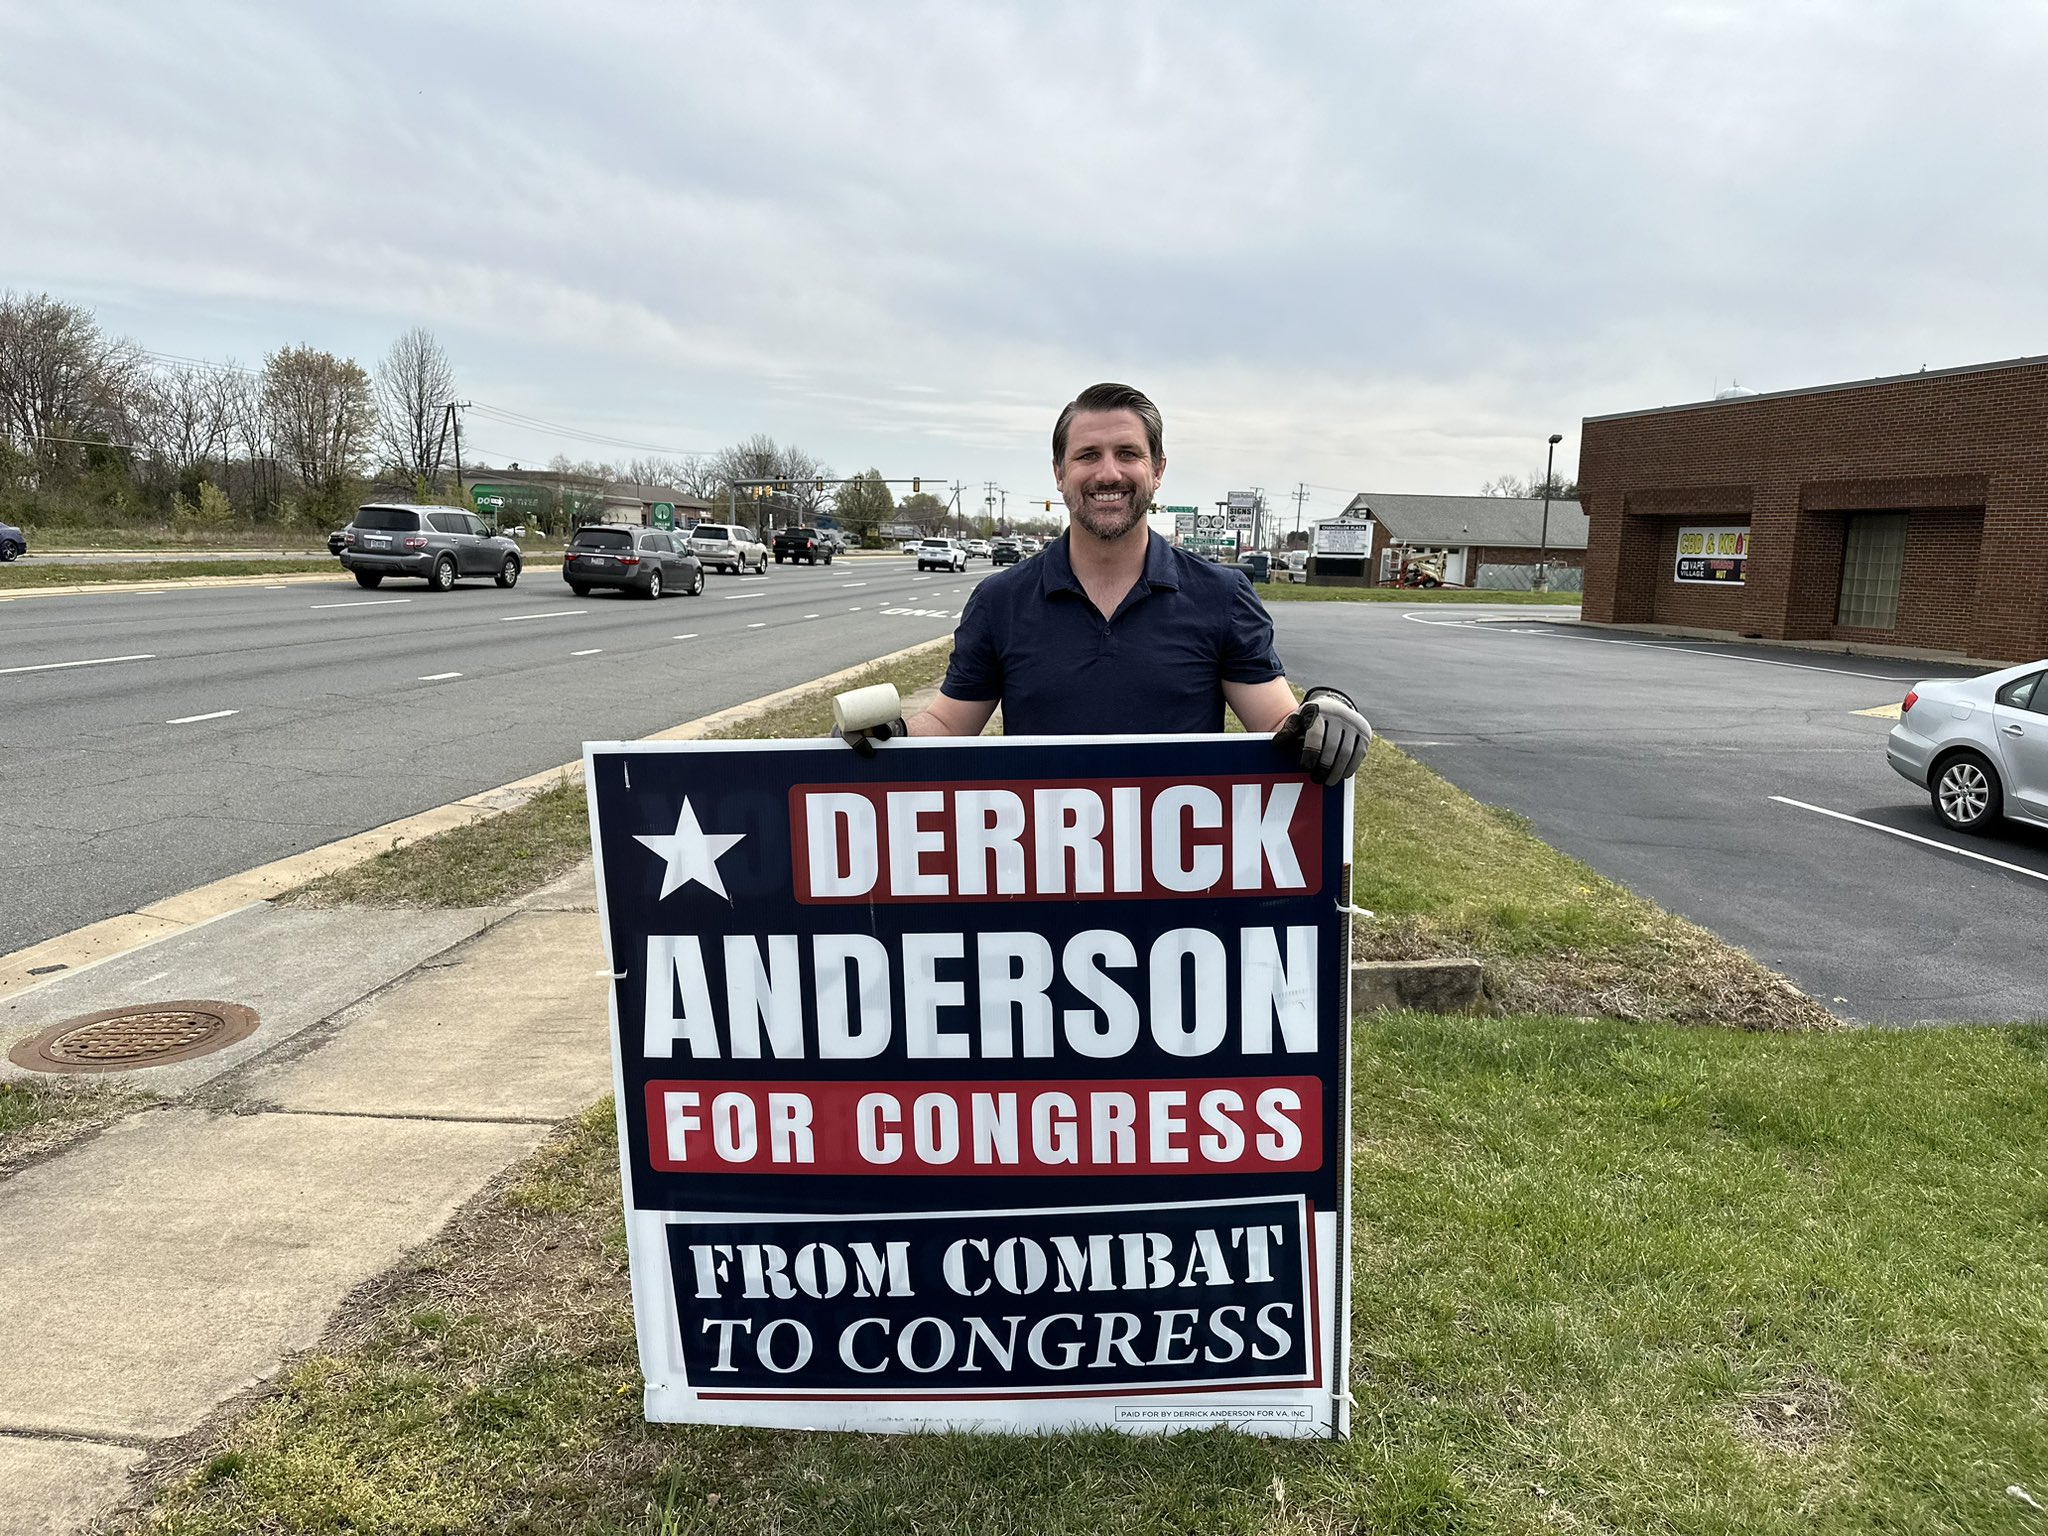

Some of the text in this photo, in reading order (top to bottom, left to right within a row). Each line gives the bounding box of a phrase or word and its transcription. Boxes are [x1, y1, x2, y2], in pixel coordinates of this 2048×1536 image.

[1681, 533, 1704, 554] CBD
[1706, 533, 1716, 555] &
[1690, 561, 1705, 571] VAPE
[806, 783, 1306, 897] DERRICK
[644, 926, 1318, 1058] ANDERSON
[664, 1088, 1302, 1164] FOR CONGRESS
[689, 1226, 1283, 1299] FROM COMBAT
[702, 1303, 1293, 1373] TO CONGRESS
